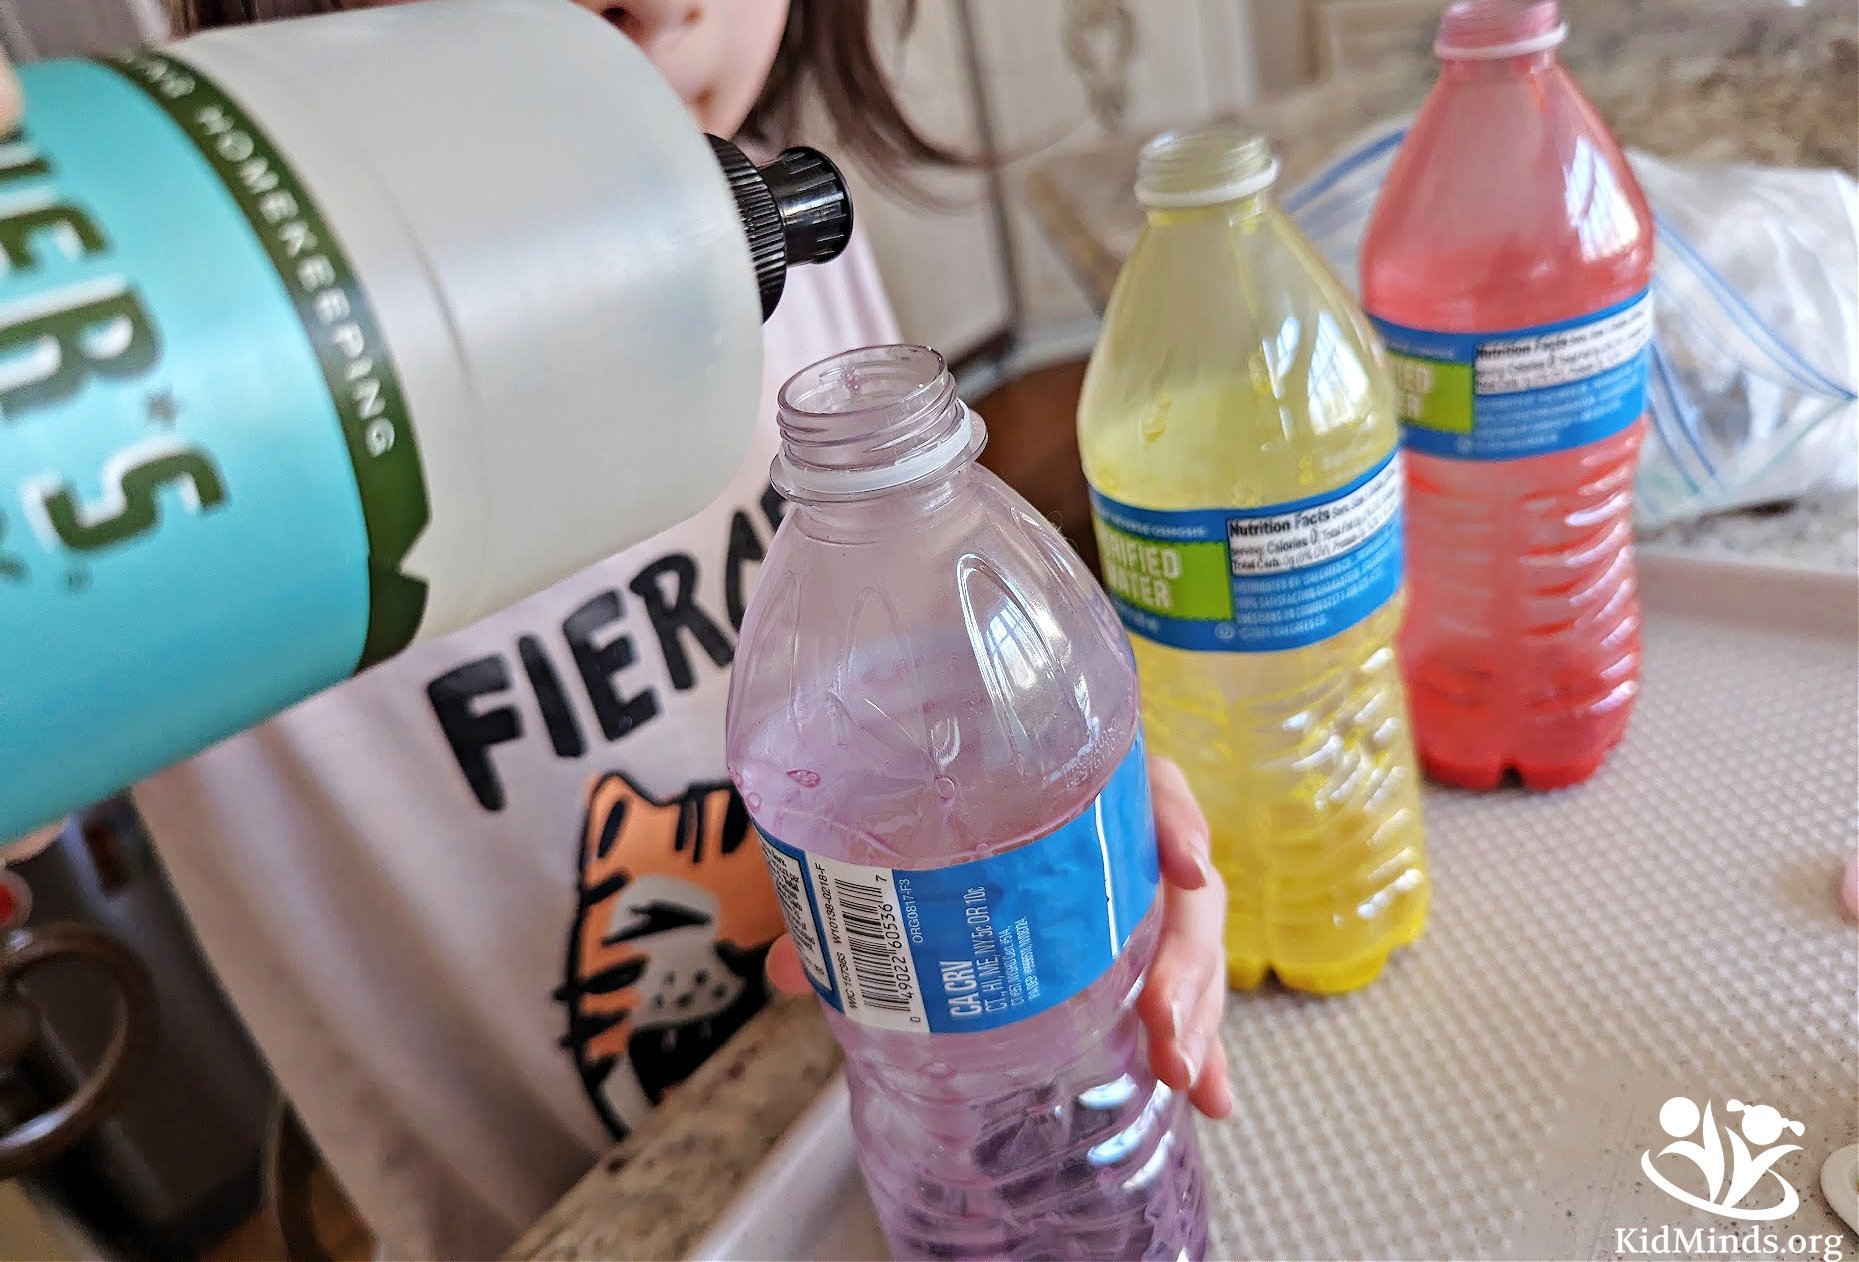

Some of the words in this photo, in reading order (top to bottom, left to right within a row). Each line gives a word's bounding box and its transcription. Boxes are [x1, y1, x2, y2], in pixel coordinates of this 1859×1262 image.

[194, 102, 395, 458] HOMEKEEPING
[1229, 519, 1291, 537] Nutrition
[1294, 509, 1330, 529] Facts
[1266, 537, 1308, 553] Calories
[1231, 560, 1255, 571] Total
[427, 476, 790, 812] FIERC
[876, 874, 887, 882] 7
[814, 862, 842, 944] W10138-0218-F
[899, 878, 924, 944] ORG0817-F3
[966, 905, 990, 924] OR
[877, 903, 902, 949] 60536
[971, 939, 996, 954] NY
[891, 956, 913, 1000] 49022
[939, 960, 977, 992] CRV
[845, 986, 858, 1009] WIC
[948, 992, 982, 1017] CA
